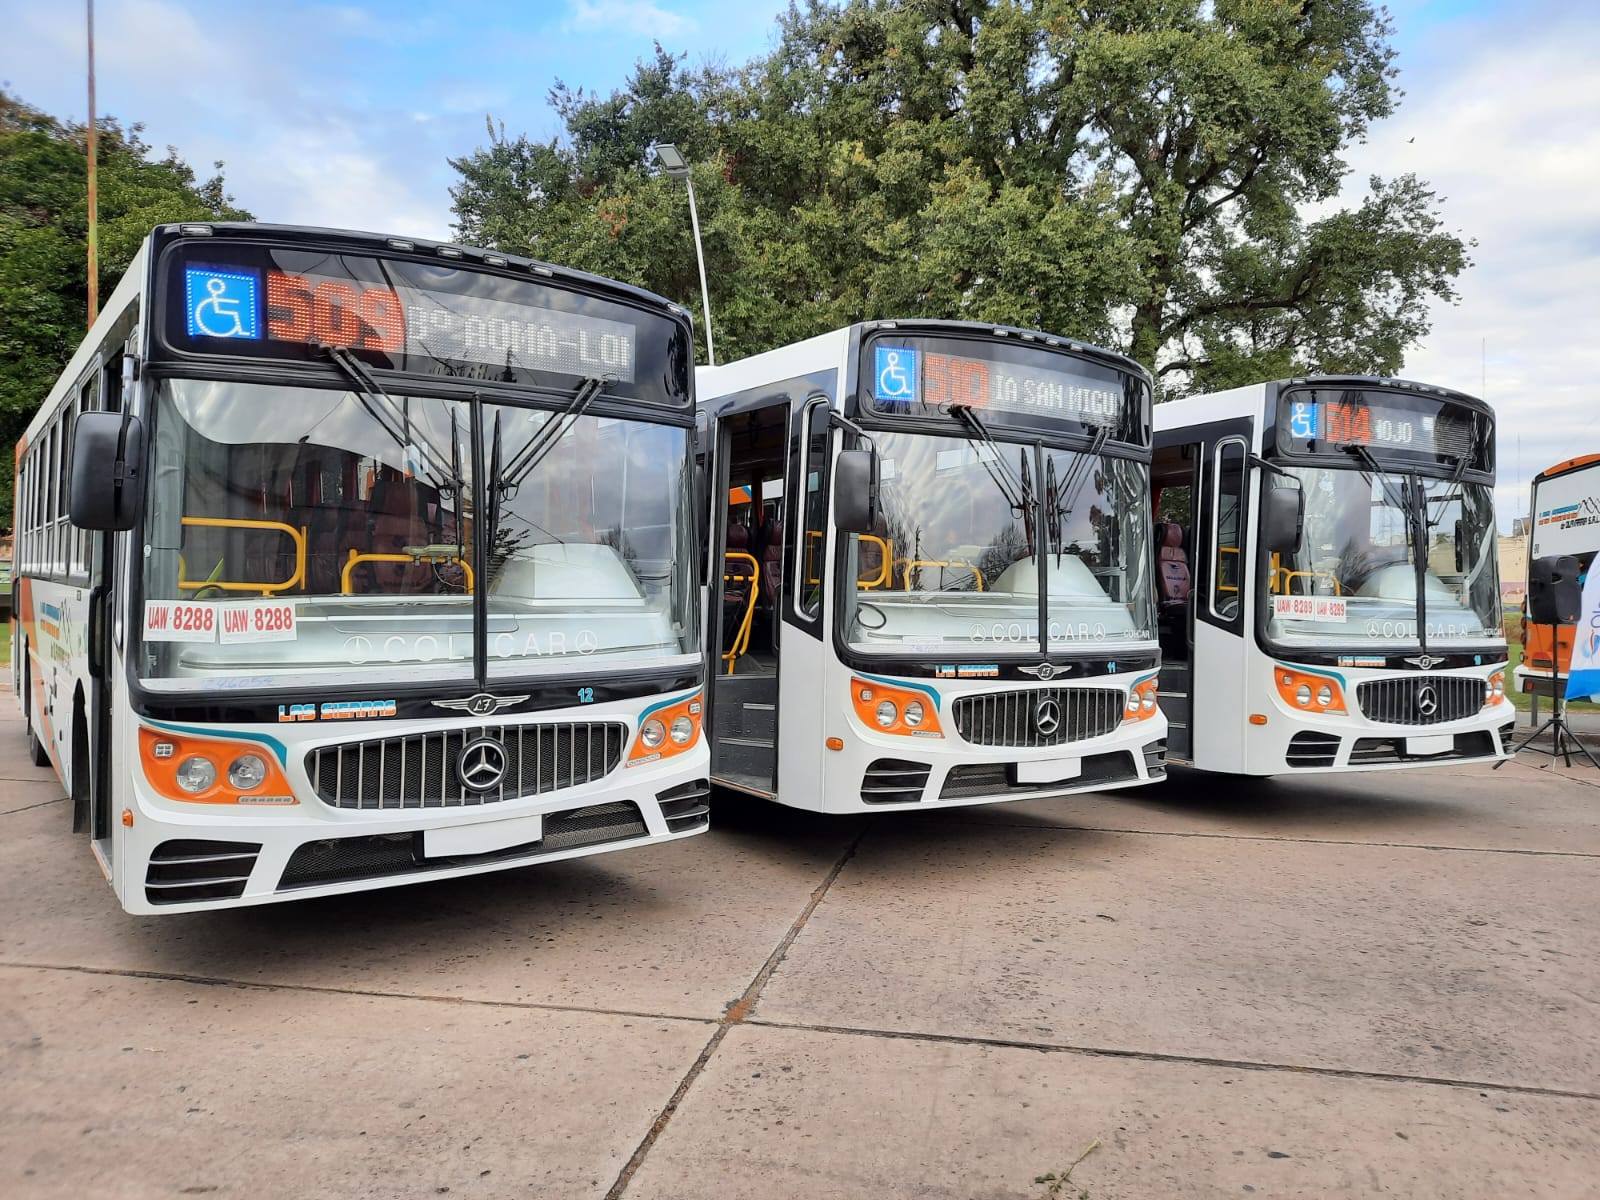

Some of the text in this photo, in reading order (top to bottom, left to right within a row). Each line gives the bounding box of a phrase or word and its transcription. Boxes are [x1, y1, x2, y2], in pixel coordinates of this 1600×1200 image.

[268, 271, 404, 351] 509
[925, 355, 989, 408] 510
[1023, 379, 1063, 409] SAN
[1327, 404, 1372, 445] 514
[1294, 600, 1312, 614] 8289
[1329, 602, 1345, 617] 8289
[173, 606, 213, 631] 8288
[255, 606, 293, 631] 8288
[991, 622, 1089, 642] COL CAR
[1382, 622, 1456, 639] COL CAR
[384, 631, 567, 662] COL CAR
[1106, 661, 1116, 673] 11
[577, 687, 594, 703] 12
[278, 703, 316, 723] LAS
